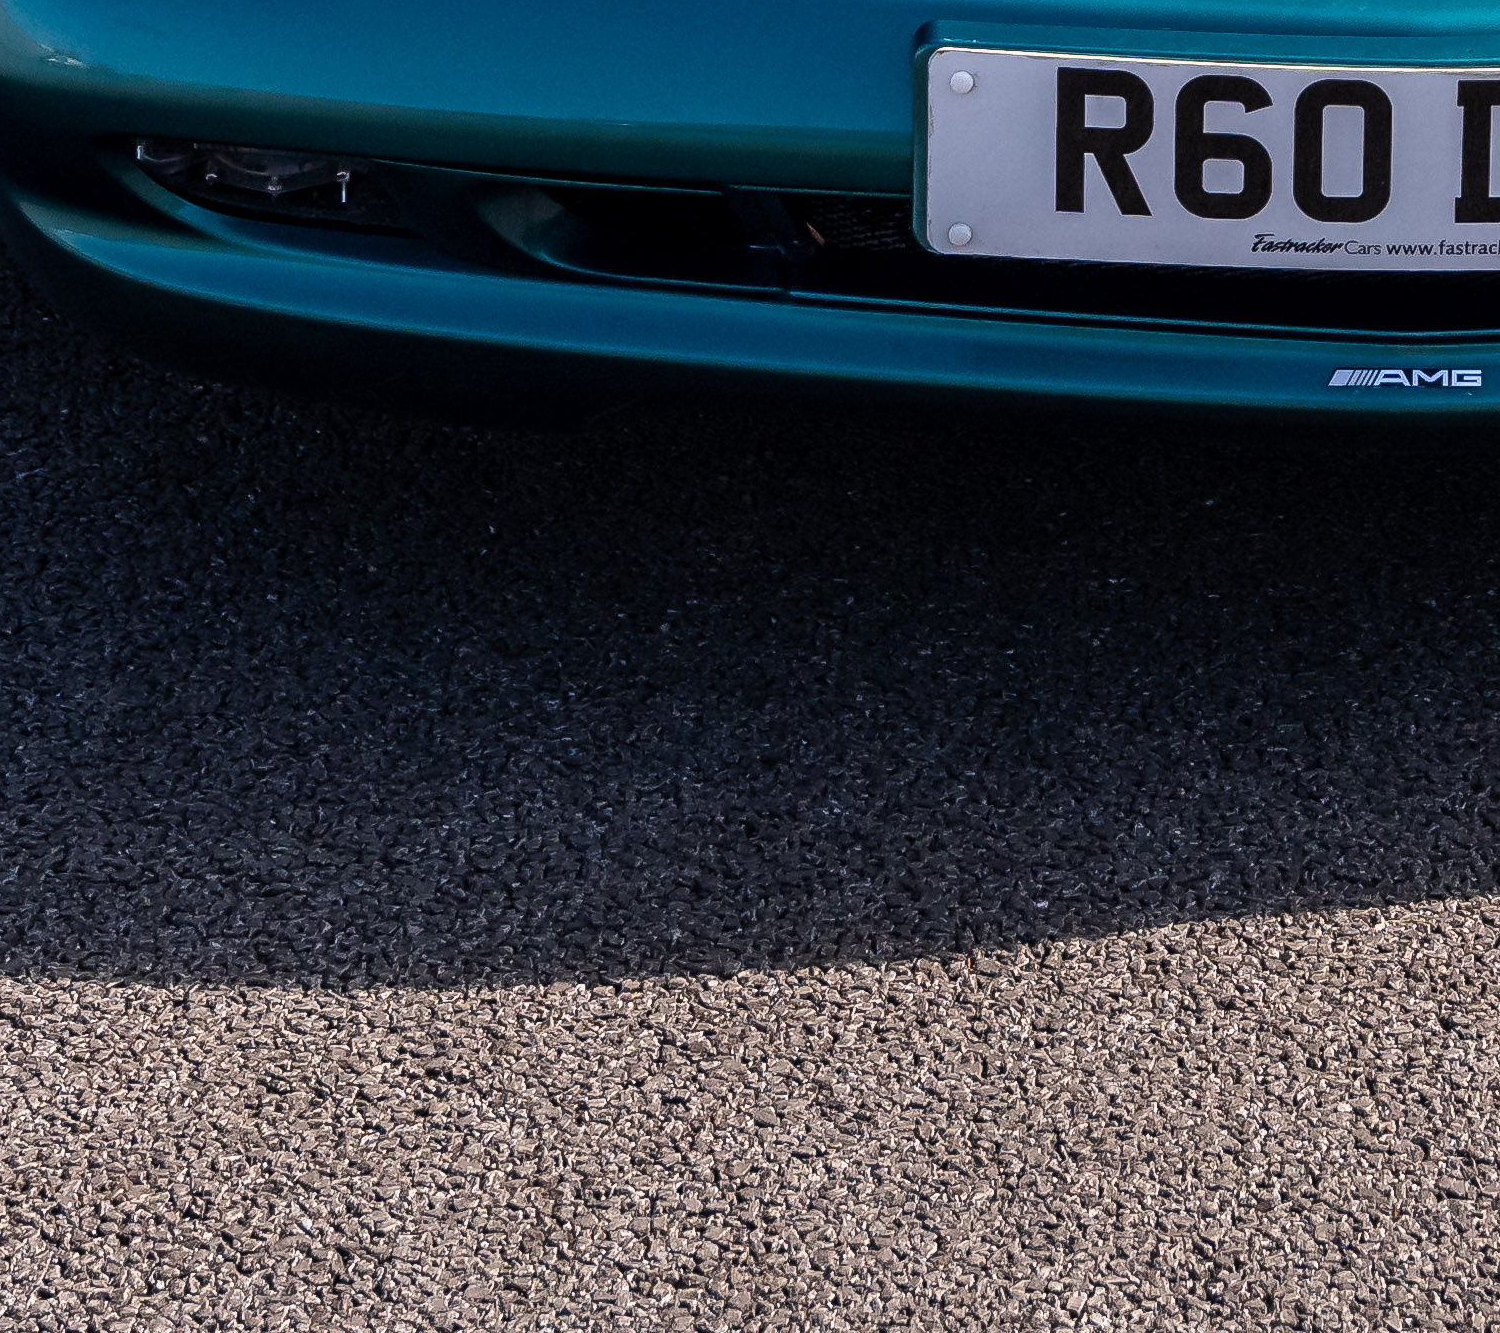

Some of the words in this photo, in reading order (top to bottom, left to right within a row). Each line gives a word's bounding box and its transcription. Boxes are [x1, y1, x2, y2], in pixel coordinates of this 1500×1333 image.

[1056, 67, 1274, 223] R60
[1251, 233, 1342, 253] Fastracker
[1343, 238, 1382, 255] Cars
[1373, 369, 1482, 387] AMG
